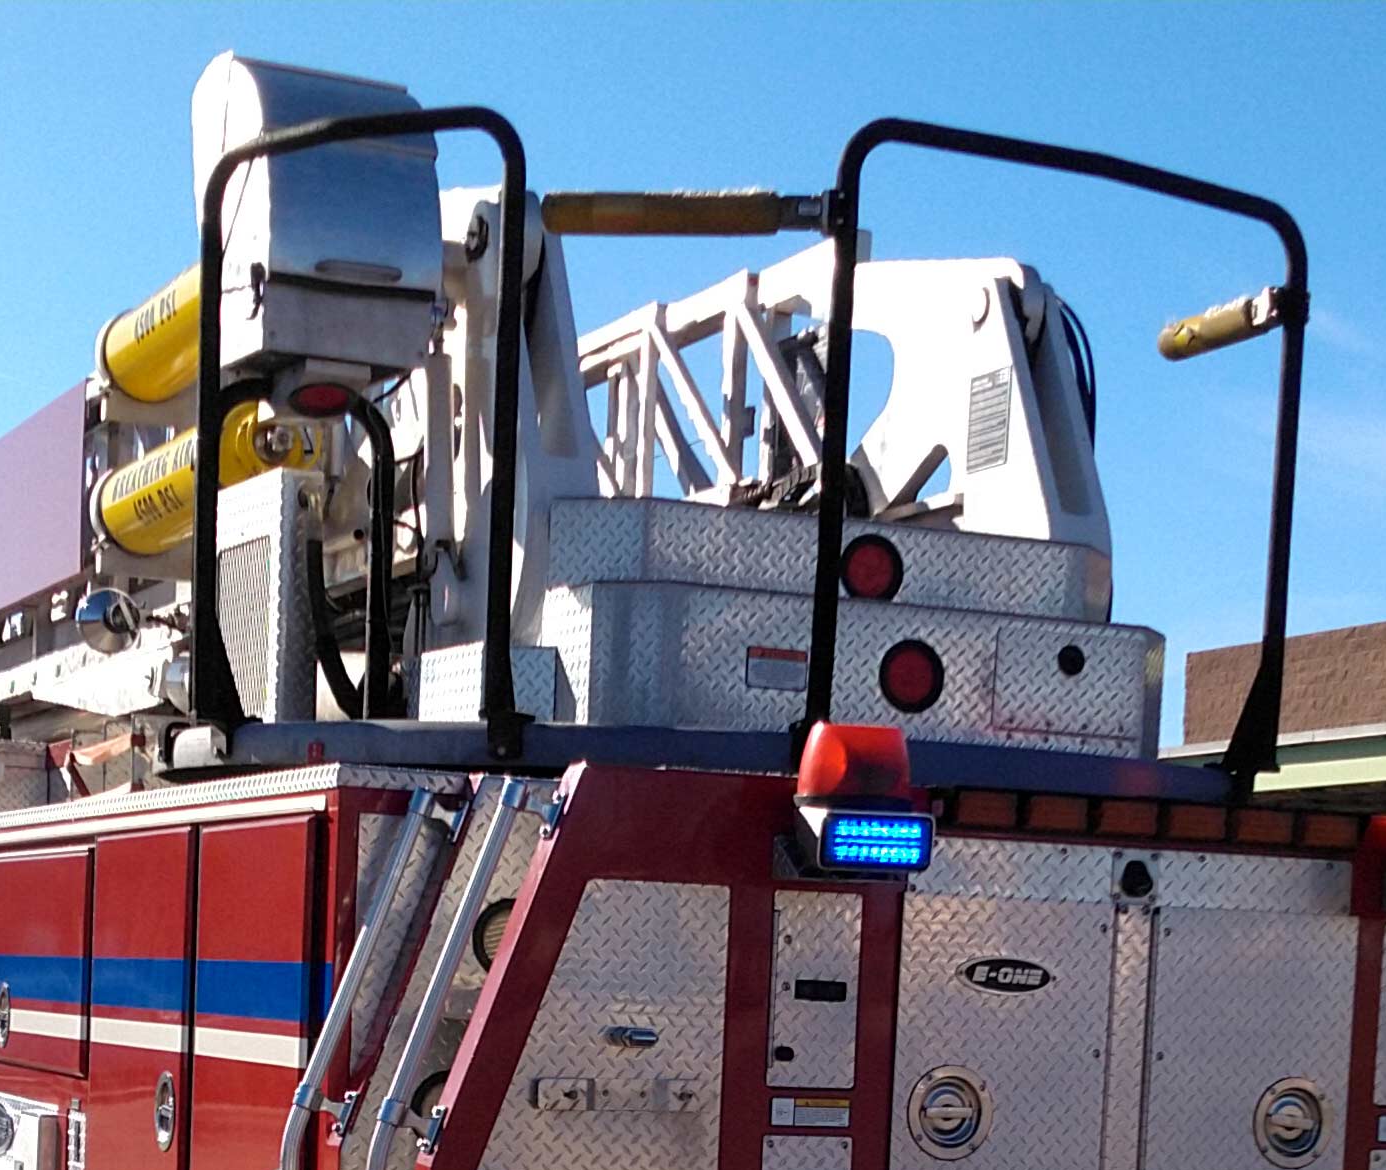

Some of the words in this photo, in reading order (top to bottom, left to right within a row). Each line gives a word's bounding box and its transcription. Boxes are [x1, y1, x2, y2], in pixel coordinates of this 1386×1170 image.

[159, 289, 177, 325] PSI
[111, 450, 170, 503] BREATHING
[157, 483, 184, 513] PSI
[971, 965, 1044, 986] E-ONE
